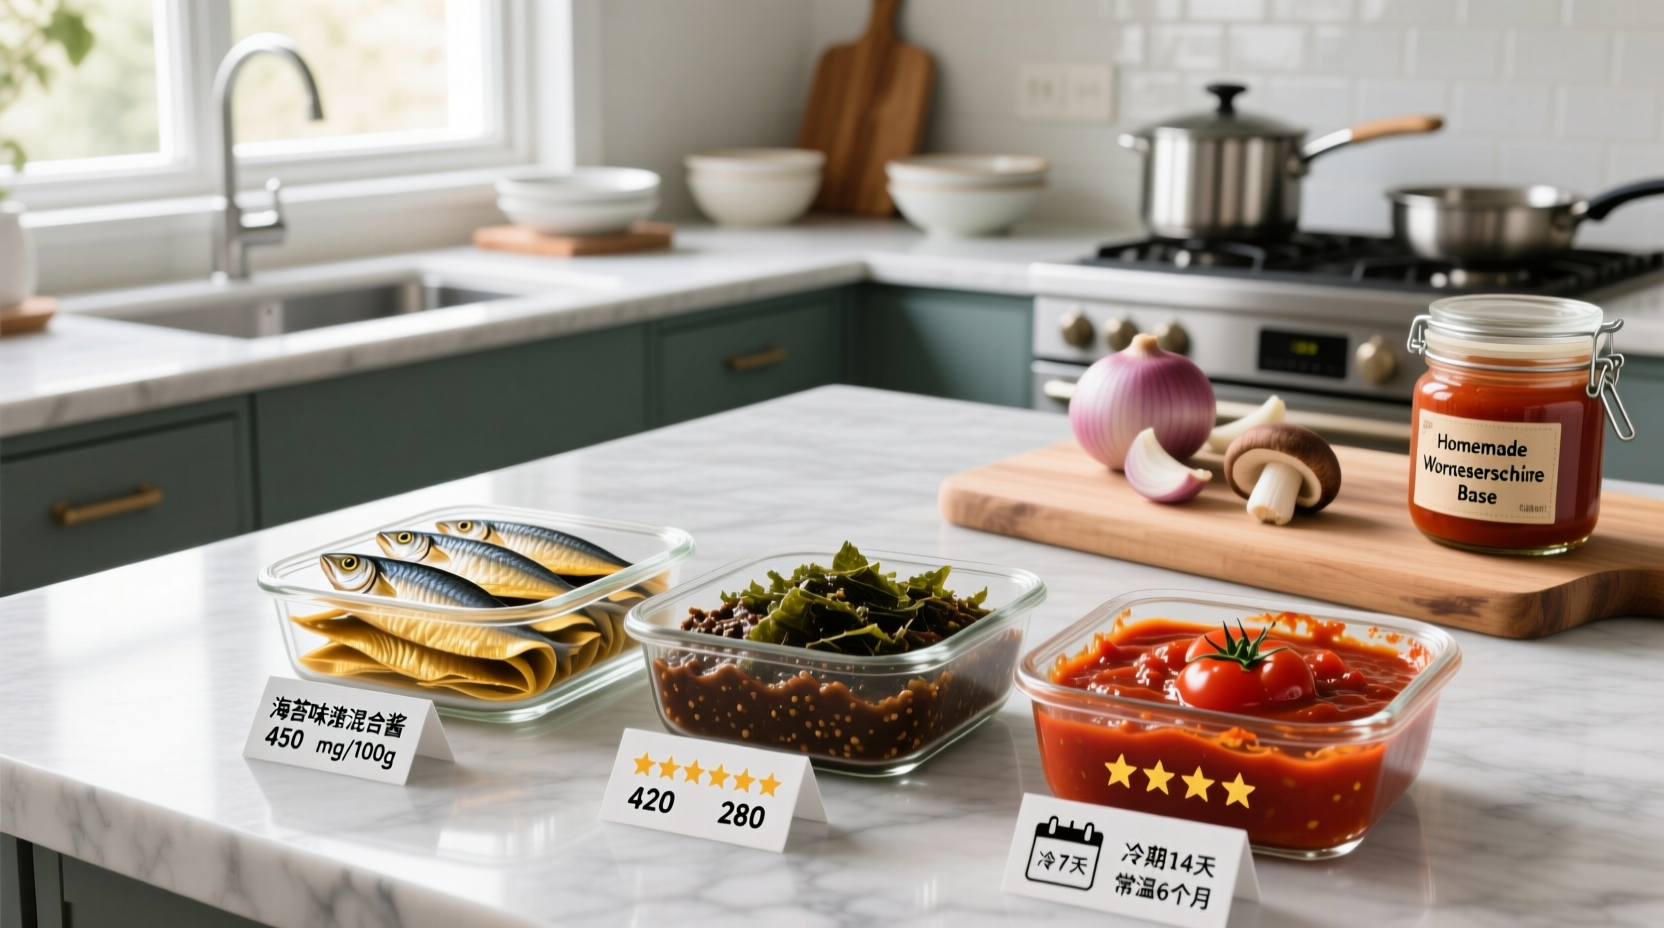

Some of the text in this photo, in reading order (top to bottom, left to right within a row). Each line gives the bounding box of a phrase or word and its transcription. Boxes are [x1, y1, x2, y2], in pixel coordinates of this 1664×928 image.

[1437, 433, 1528, 457] Homemade
[1457, 484, 1498, 505] Base
[265, 726, 396, 770] 450 mg/100g
[628, 786, 766, 829] 420 280
[1121, 842, 1216, 878] 冷期14天
[1115, 872, 1211, 910] 常温6个月
